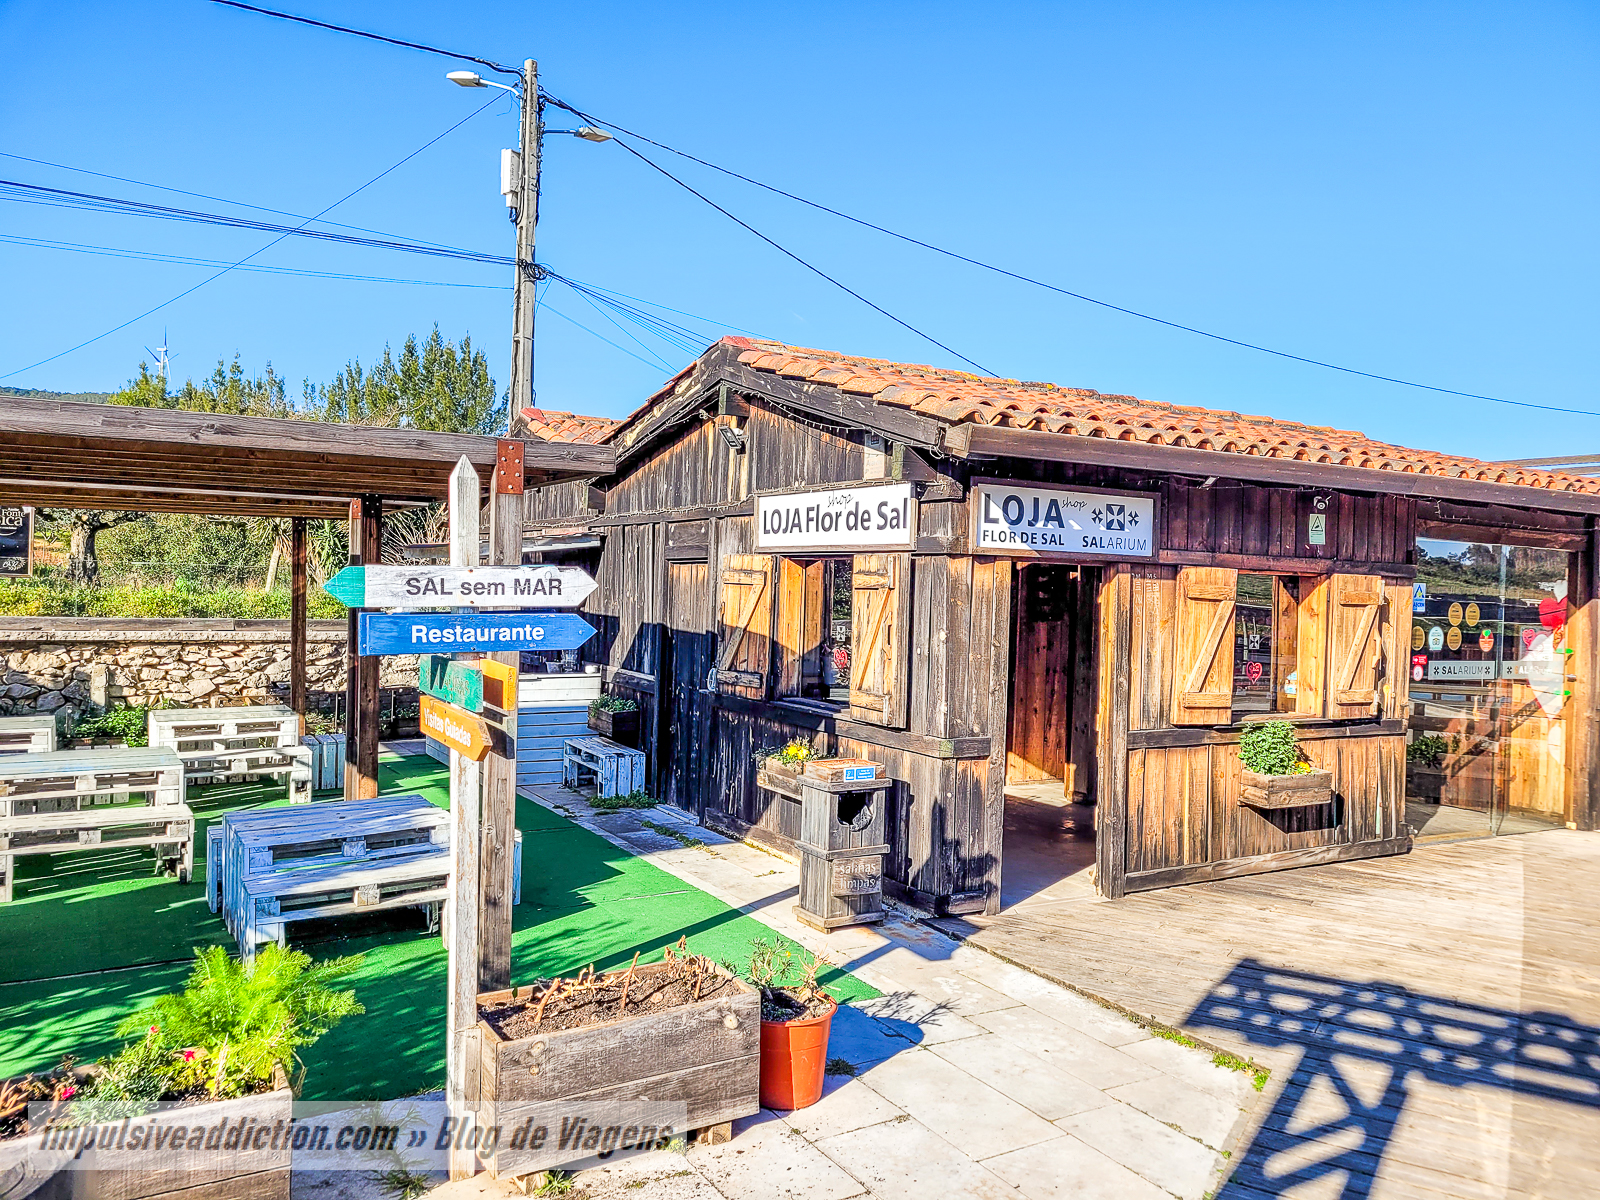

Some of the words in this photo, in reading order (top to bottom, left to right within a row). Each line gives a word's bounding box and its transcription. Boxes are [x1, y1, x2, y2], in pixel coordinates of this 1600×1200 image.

[827, 485, 854, 509] shop
[763, 508, 803, 535] LOJA
[806, 504, 843, 533] Flor
[846, 501, 872, 532] de
[876, 497, 909, 531] Sal
[983, 493, 1066, 529] LOJA
[1061, 496, 1088, 513] shop
[0, 515, 23, 527] ica
[982, 529, 1017, 544] FLOR
[1020, 532, 1038, 545] DE
[1041, 533, 1065, 546] SAL
[1082, 535, 1147, 552] SALARIUM
[405, 577, 453, 596] SAL
[460, 581, 505, 596] sem
[513, 578, 562, 596] MAR
[411, 624, 545, 643] Restaurante
[1441, 665, 1484, 675] SALARIUM
[423, 707, 444, 734] Visitas
[444, 717, 472, 748] Guiadas
[839, 862, 876, 875] salinas
[840, 877, 876, 890] limpas
